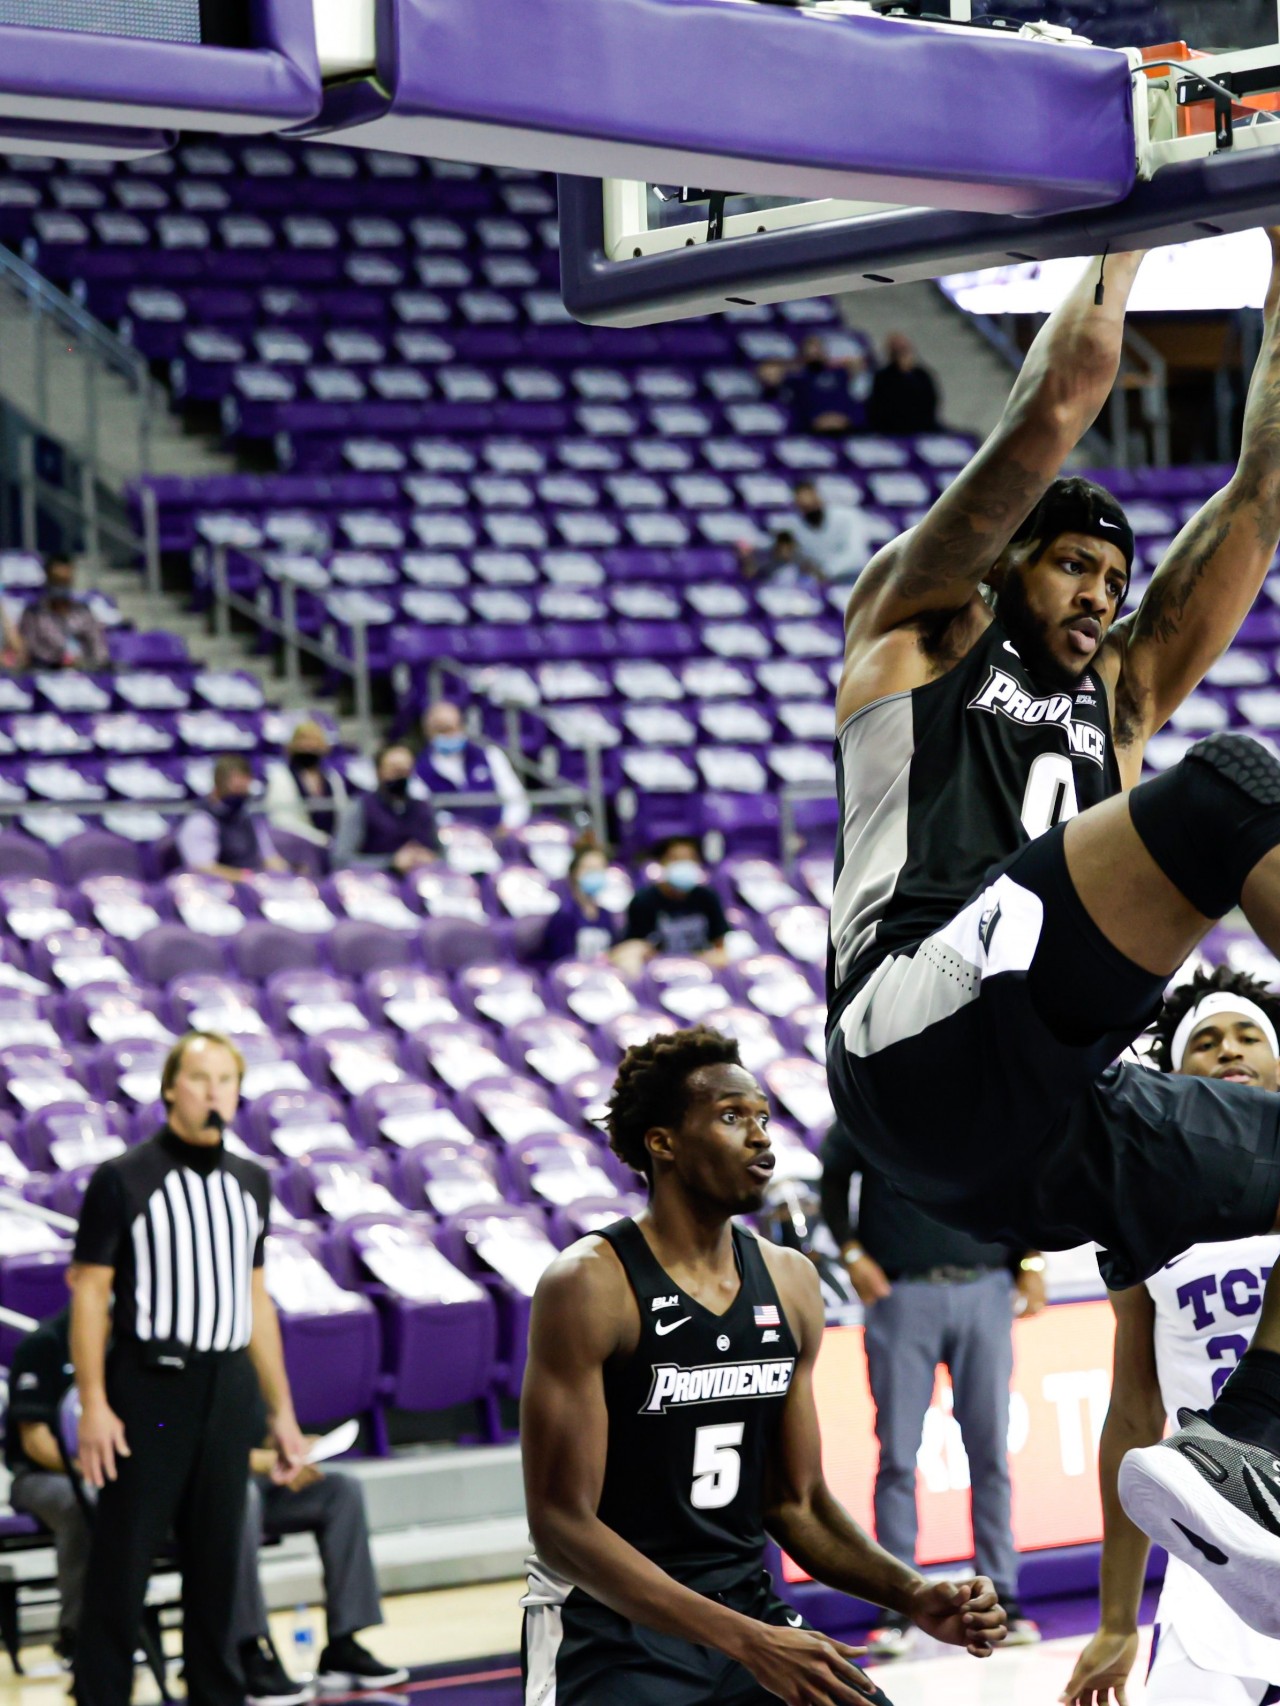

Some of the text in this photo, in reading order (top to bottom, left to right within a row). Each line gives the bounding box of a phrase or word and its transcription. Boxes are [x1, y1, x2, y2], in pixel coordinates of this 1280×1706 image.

[1021, 752, 1079, 840] 0
[1176, 1267, 1274, 1332] TC
[644, 1360, 794, 1412] PROVIDENCE
[690, 1422, 745, 1510] 5
